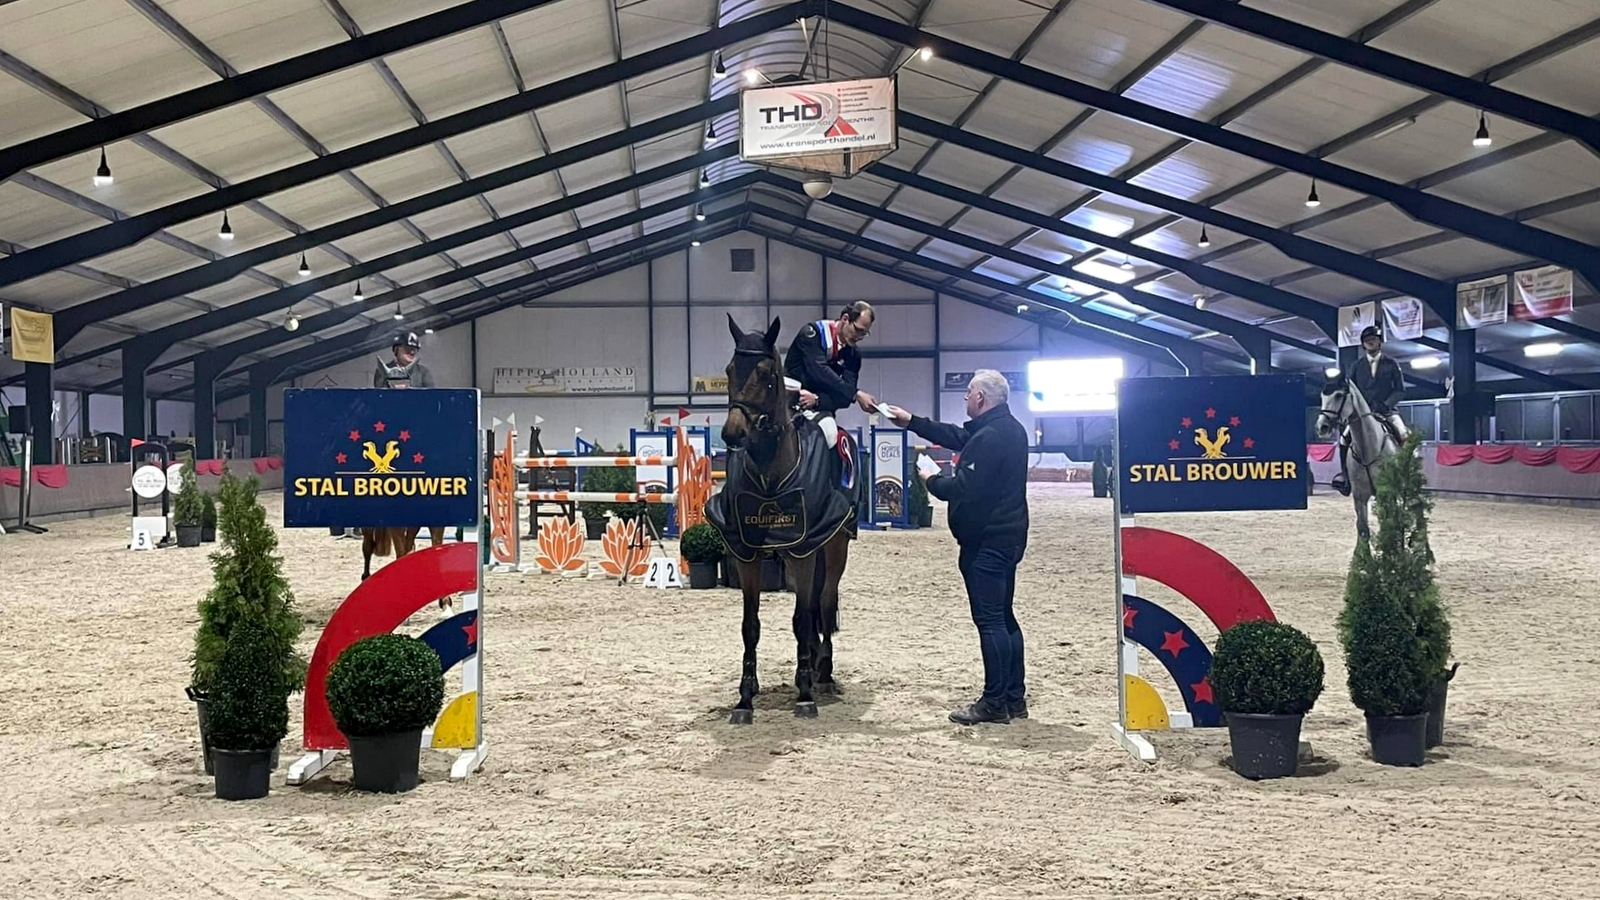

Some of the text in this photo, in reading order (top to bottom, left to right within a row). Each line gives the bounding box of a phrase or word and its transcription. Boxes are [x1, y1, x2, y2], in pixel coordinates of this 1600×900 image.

[760, 103, 822, 123] THD
[760, 134, 876, 150] www.transporthandel.nl
[496, 367, 634, 378] HIPPO HOLLAND
[1129, 461, 1297, 483] STAL BROUWER
[294, 477, 468, 496] STAL BROUWER
[745, 514, 796, 524] EQUIFIRST
[139, 533, 145, 546] 5
[651, 562, 657, 582] 2
[667, 563, 675, 582] 2
